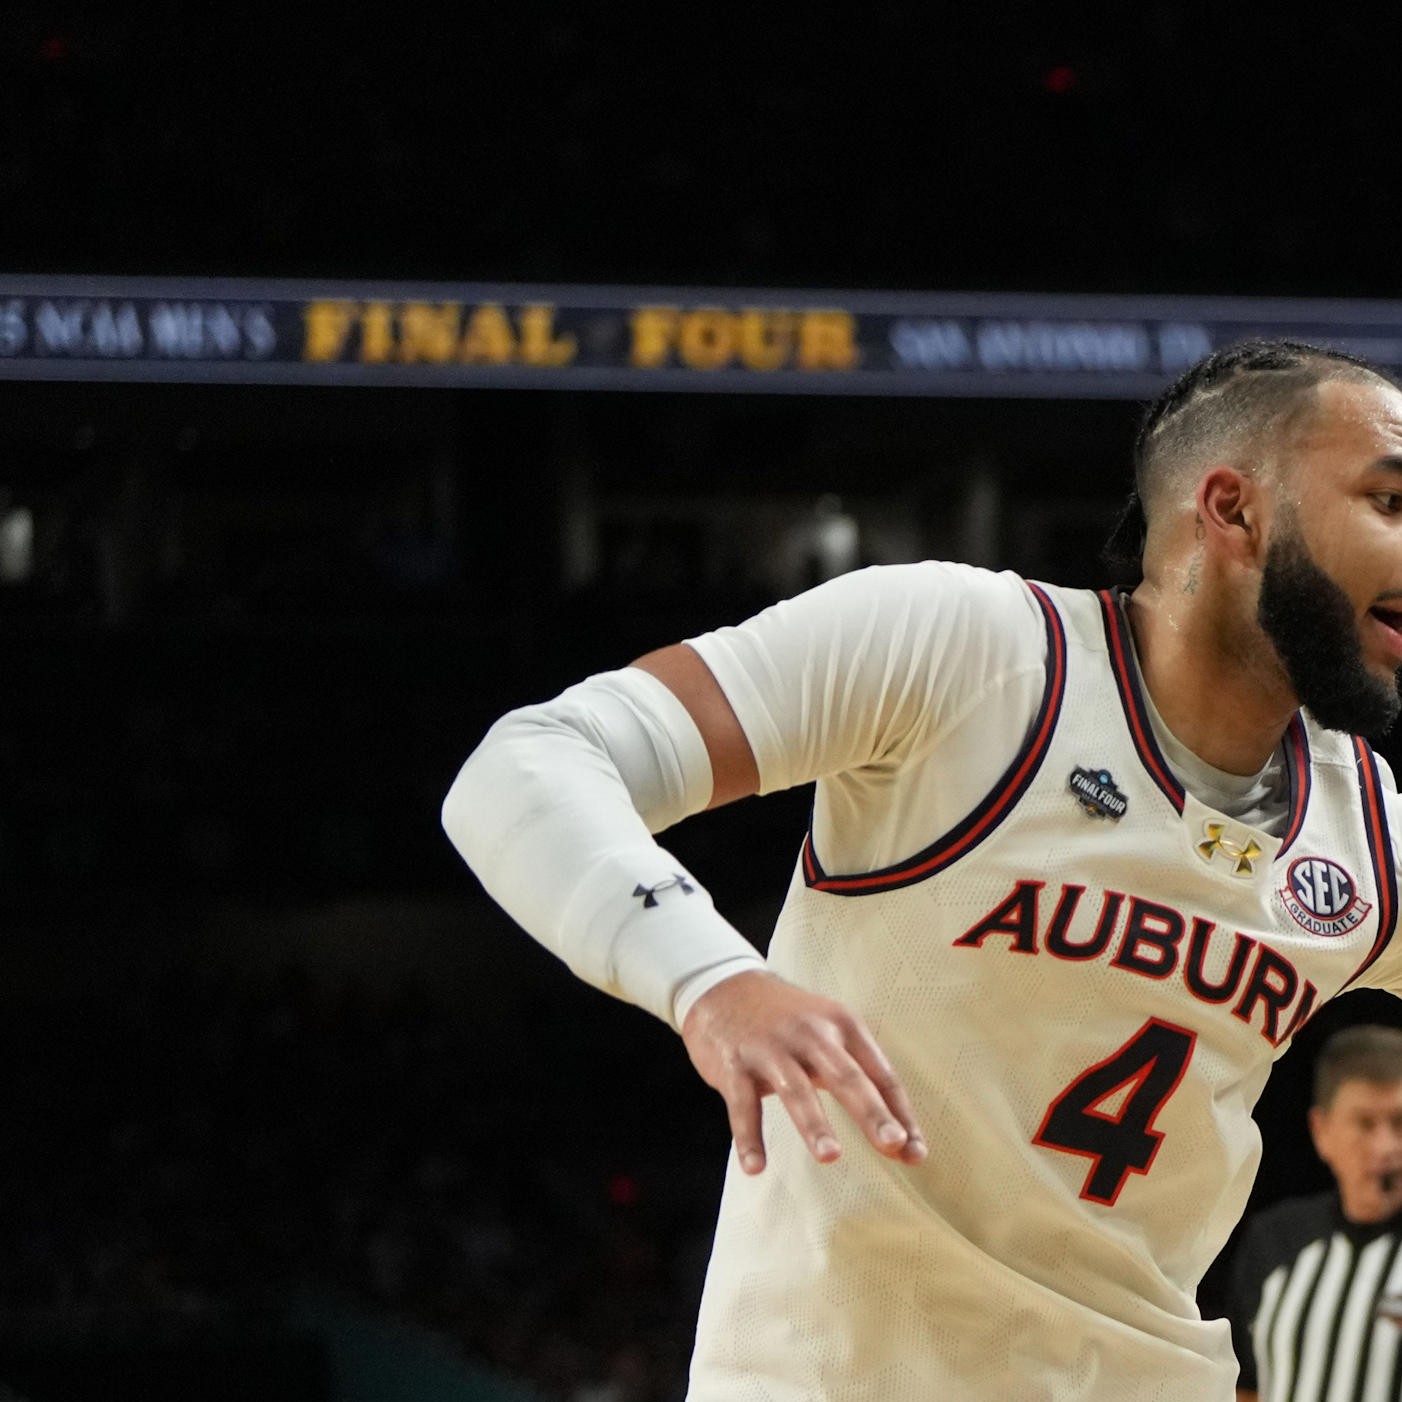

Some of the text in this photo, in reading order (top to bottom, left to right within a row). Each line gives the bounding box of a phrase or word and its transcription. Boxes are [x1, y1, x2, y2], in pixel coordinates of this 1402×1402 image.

[303, 298, 578, 366] FINAL
[628, 305, 860, 371] FOUR
[1071, 773, 1126, 814] FINAL FOUR
[1293, 860, 1350, 915] SEC
[1290, 903, 1359, 934] GRADUATE
[1031, 1016, 1198, 1208] 4
